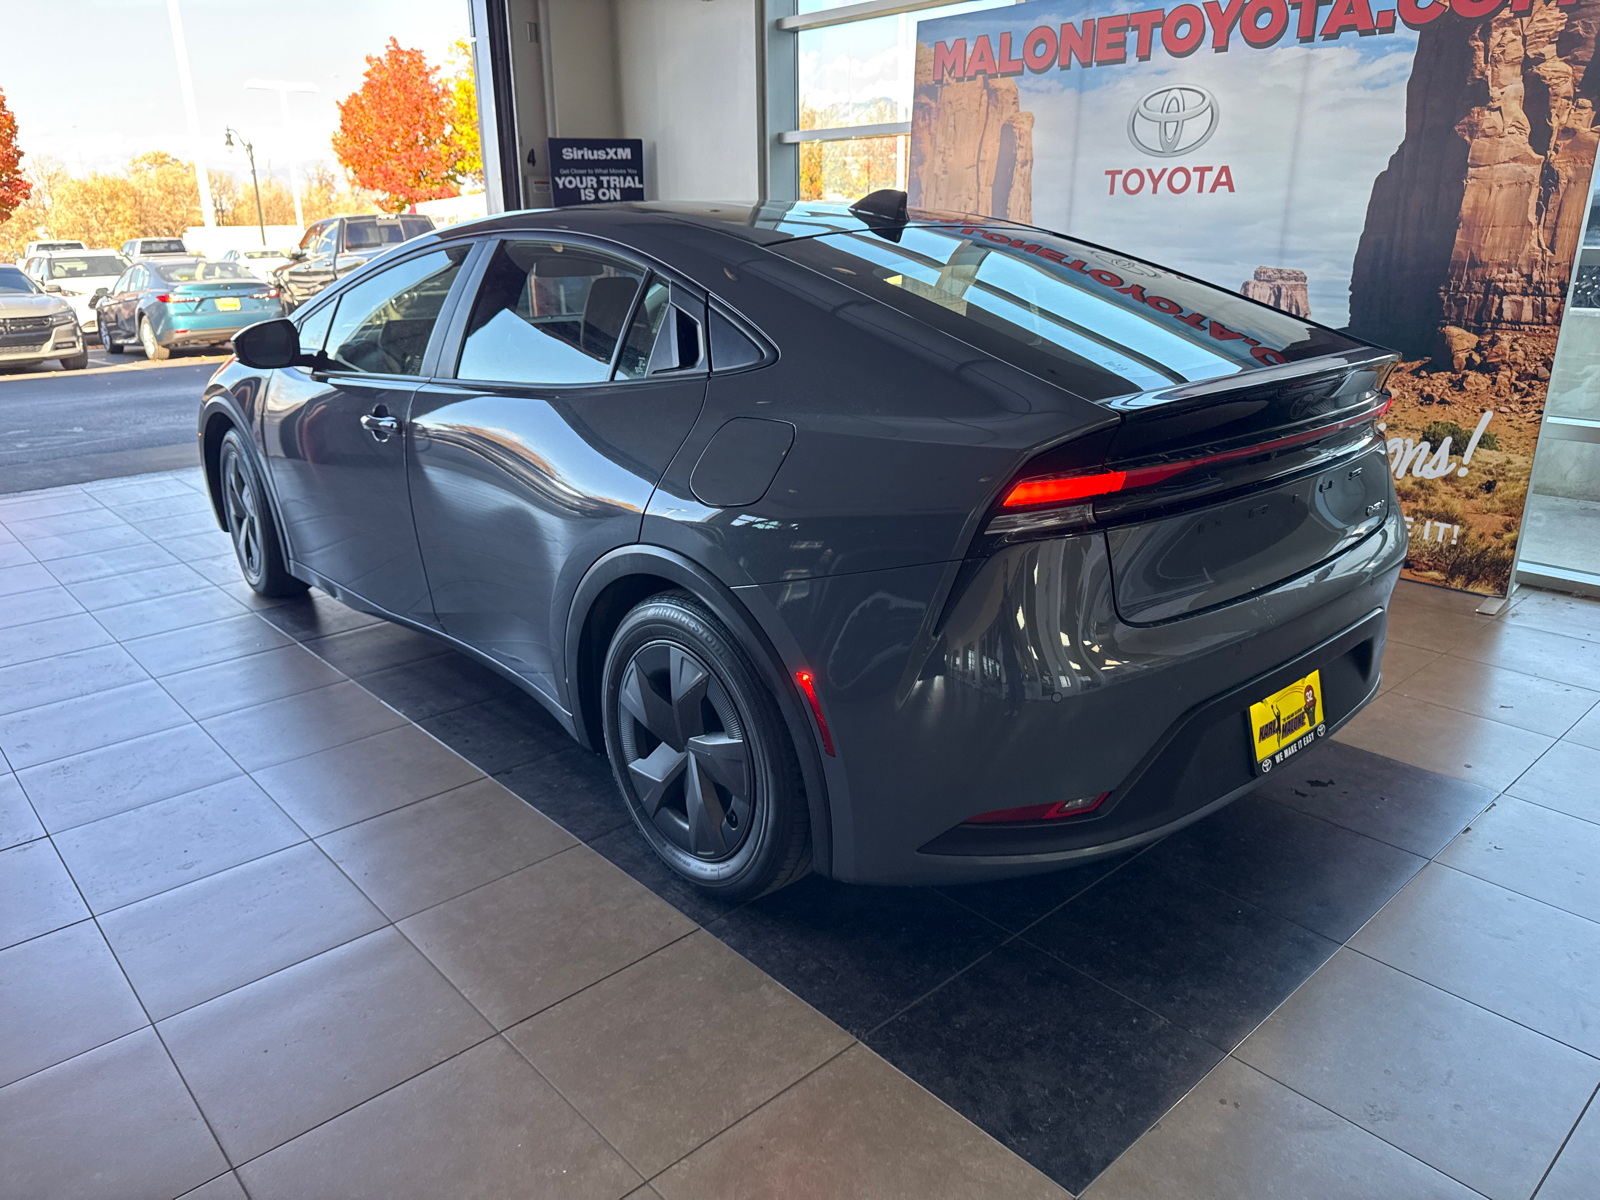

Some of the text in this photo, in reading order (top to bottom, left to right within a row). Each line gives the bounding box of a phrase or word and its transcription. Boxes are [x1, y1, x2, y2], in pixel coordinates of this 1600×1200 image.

[527, 148, 537, 167] 4
[562, 147, 632, 160] SiriusXM
[554, 176, 598, 189] YOUR
[599, 175, 643, 188] TRIAL
[1104, 165, 1236, 196] TOYOTA
[580, 188, 621, 201] IS ON
[1422, 520, 1460, 545] IT!
[1305, 689, 1313, 702] 32
[1258, 718, 1278, 744] KARL
[1275, 732, 1315, 764] WE MAKE IT EASY
